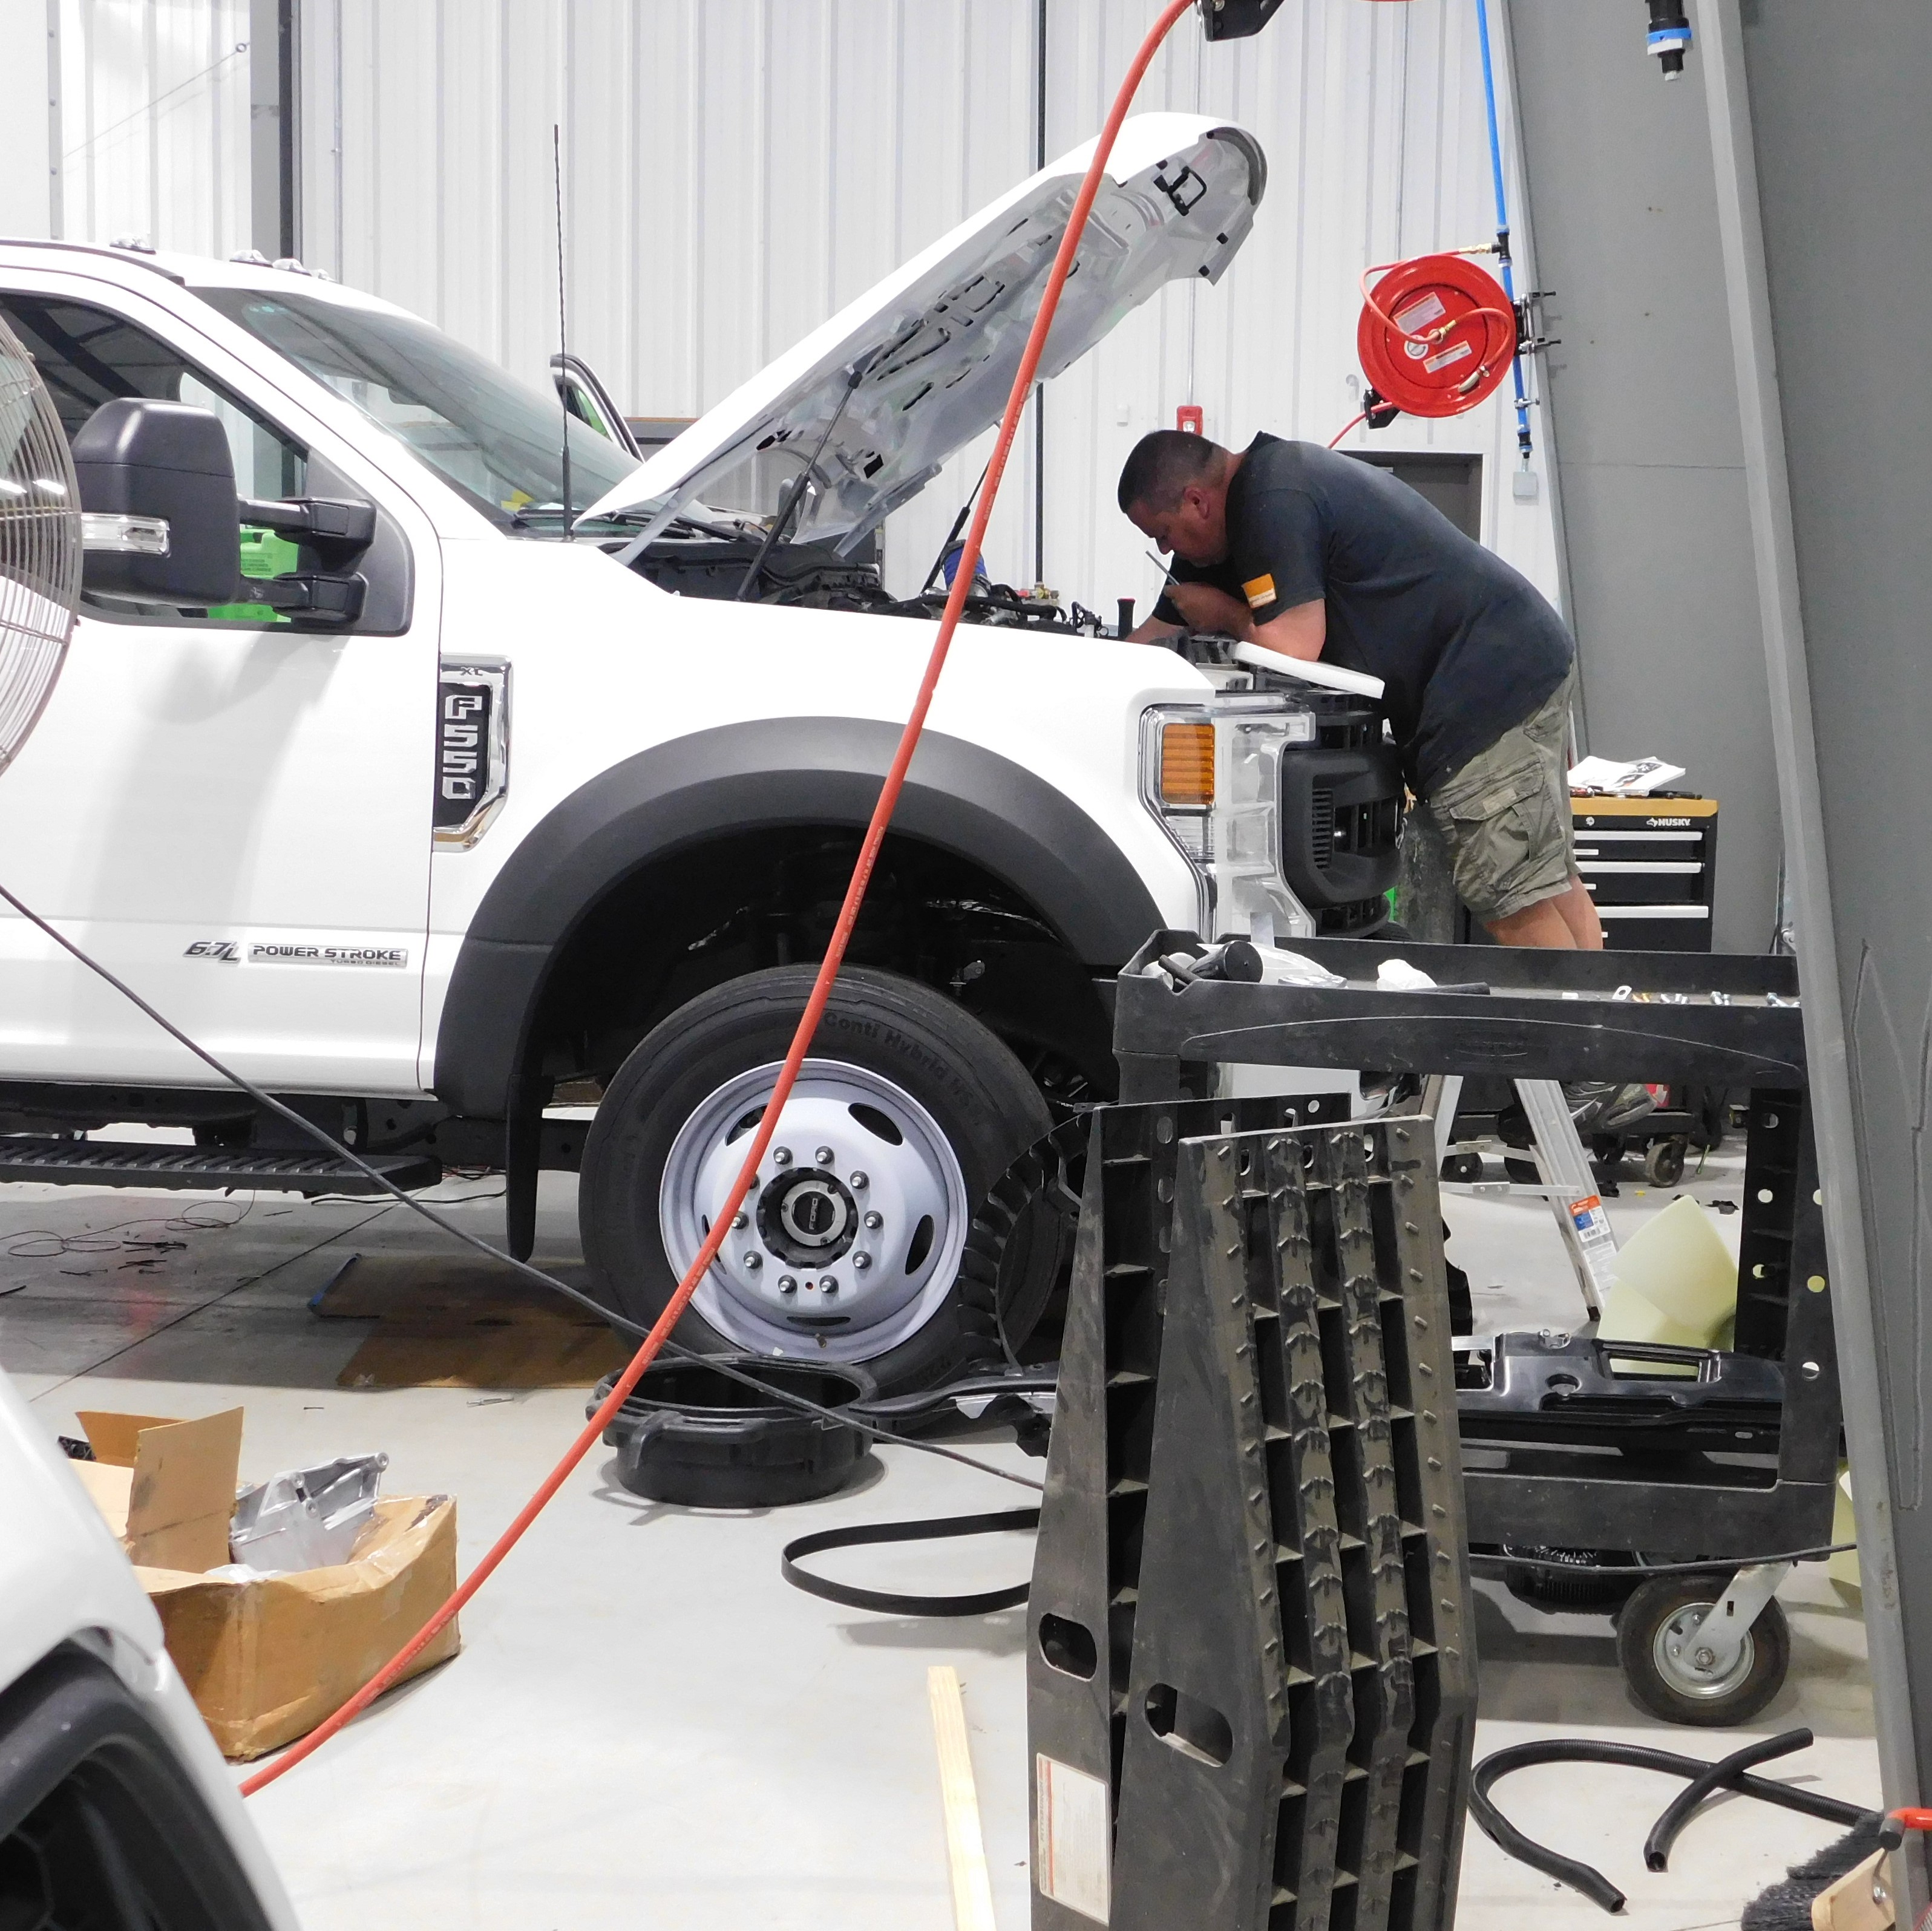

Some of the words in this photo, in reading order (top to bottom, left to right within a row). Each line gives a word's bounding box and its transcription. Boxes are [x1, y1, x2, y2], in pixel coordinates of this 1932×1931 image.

[460, 667, 483, 676] XL
[1658, 818, 1691, 826] HUSKY
[183, 941, 240, 962] 6.7L
[253, 945, 319, 958] POWER
[324, 948, 402, 961] STROKE
[824, 1012, 880, 1039] Conti
[884, 1030, 950, 1080] Hybrid
[809, 1198, 818, 1230] FORD
